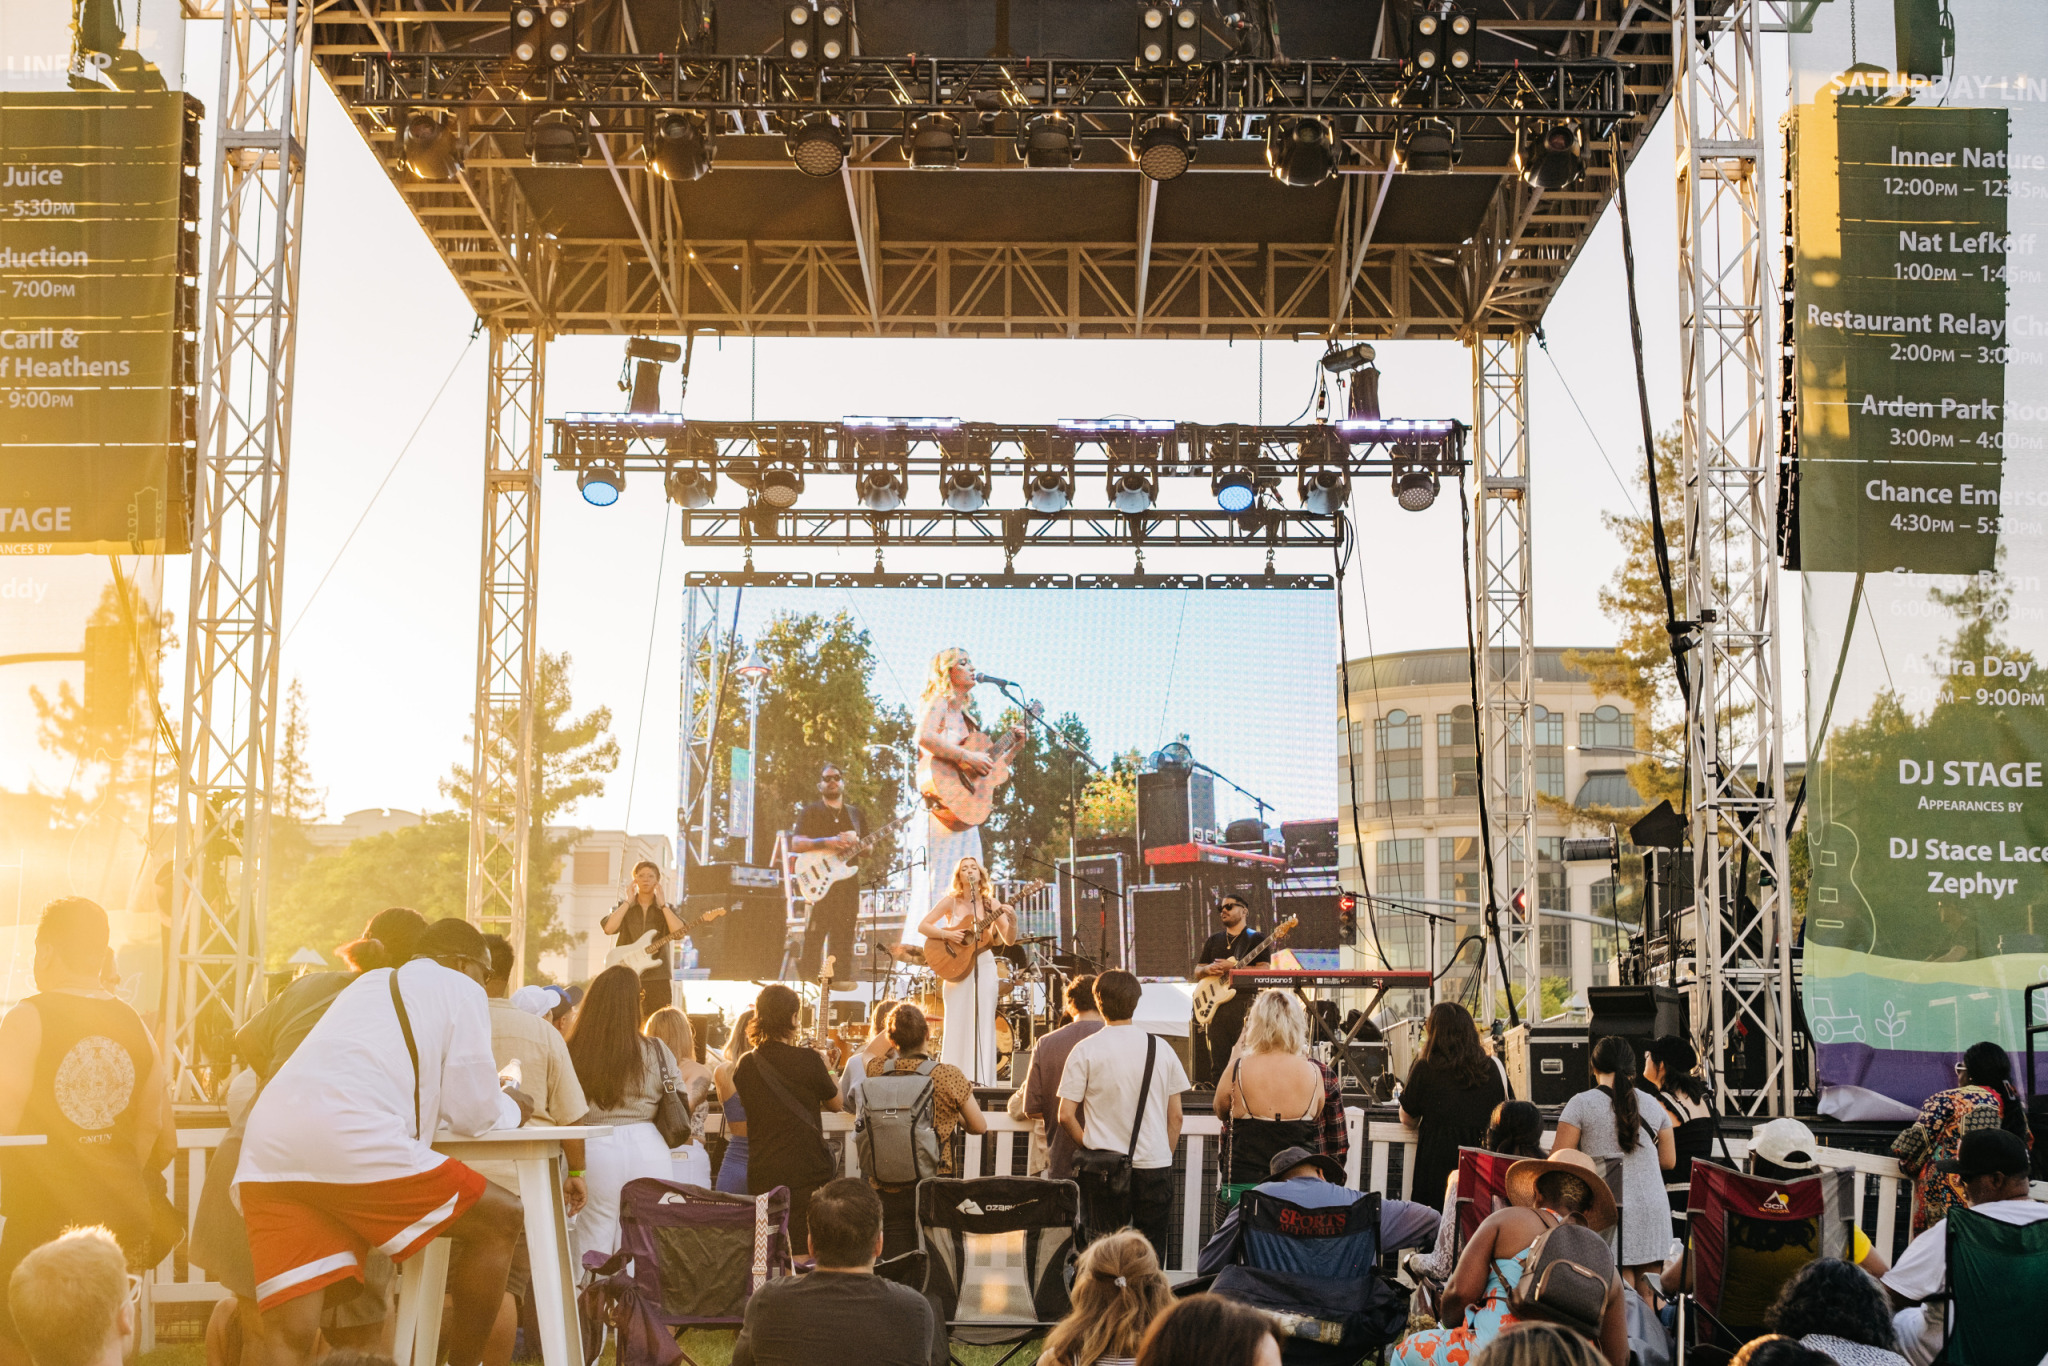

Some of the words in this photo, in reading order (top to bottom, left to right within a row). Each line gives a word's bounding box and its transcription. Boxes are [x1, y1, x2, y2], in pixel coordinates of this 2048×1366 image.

[1830, 72, 1992, 100] SATURDAY
[1891, 146, 1956, 167] Inner
[1963, 147, 2046, 170] Nature
[3, 165, 63, 187] Juice
[1883, 178, 1958, 197] 12:00PM
[13, 199, 75, 217] 5:30PM
[1899, 231, 1942, 252] Nat
[1950, 231, 2037, 255] Lefkoff
[1893, 262, 1957, 281] 1:00PM
[1980, 265, 2041, 283] 1:45PM
[12, 280, 75, 298] 7:00PM
[1807, 303, 1932, 333] Restaurant
[1939, 313, 2006, 341] Relay
[0, 327, 53, 349] Carll
[60, 327, 79, 349] &
[1890, 343, 1955, 362] 2:00PM
[1977, 346, 2043, 365] 3:00PM
[15, 355, 130, 378] Heathens
[8, 391, 73, 408] 9:00PM
[1861, 394, 1934, 418] Arden
[1941, 397, 1997, 420] Park
[1890, 428, 1954, 447] 3:00PM
[1975, 431, 2043, 449] 4:00PM
[1865, 480, 1953, 503] Chance
[0, 507, 72, 532] TAGE
[1890, 513, 1954, 533] 4:30PM
[1976, 516, 2042, 535] 5:30PM
[37, 543, 52, 554] BY
[1983, 656, 2033, 683] Day
[1976, 688, 2045, 706] 9:00PM
[1899, 759, 1934, 785] DJ
[1943, 761, 2043, 787] STAGE
[1890, 837, 1918, 859] DJ
[1925, 838, 1992, 861] Stace
[1927, 871, 2018, 900] Zephyr
[985, 1204, 1016, 1212] OZAR
[1280, 1208, 1345, 1228] SPORTS
